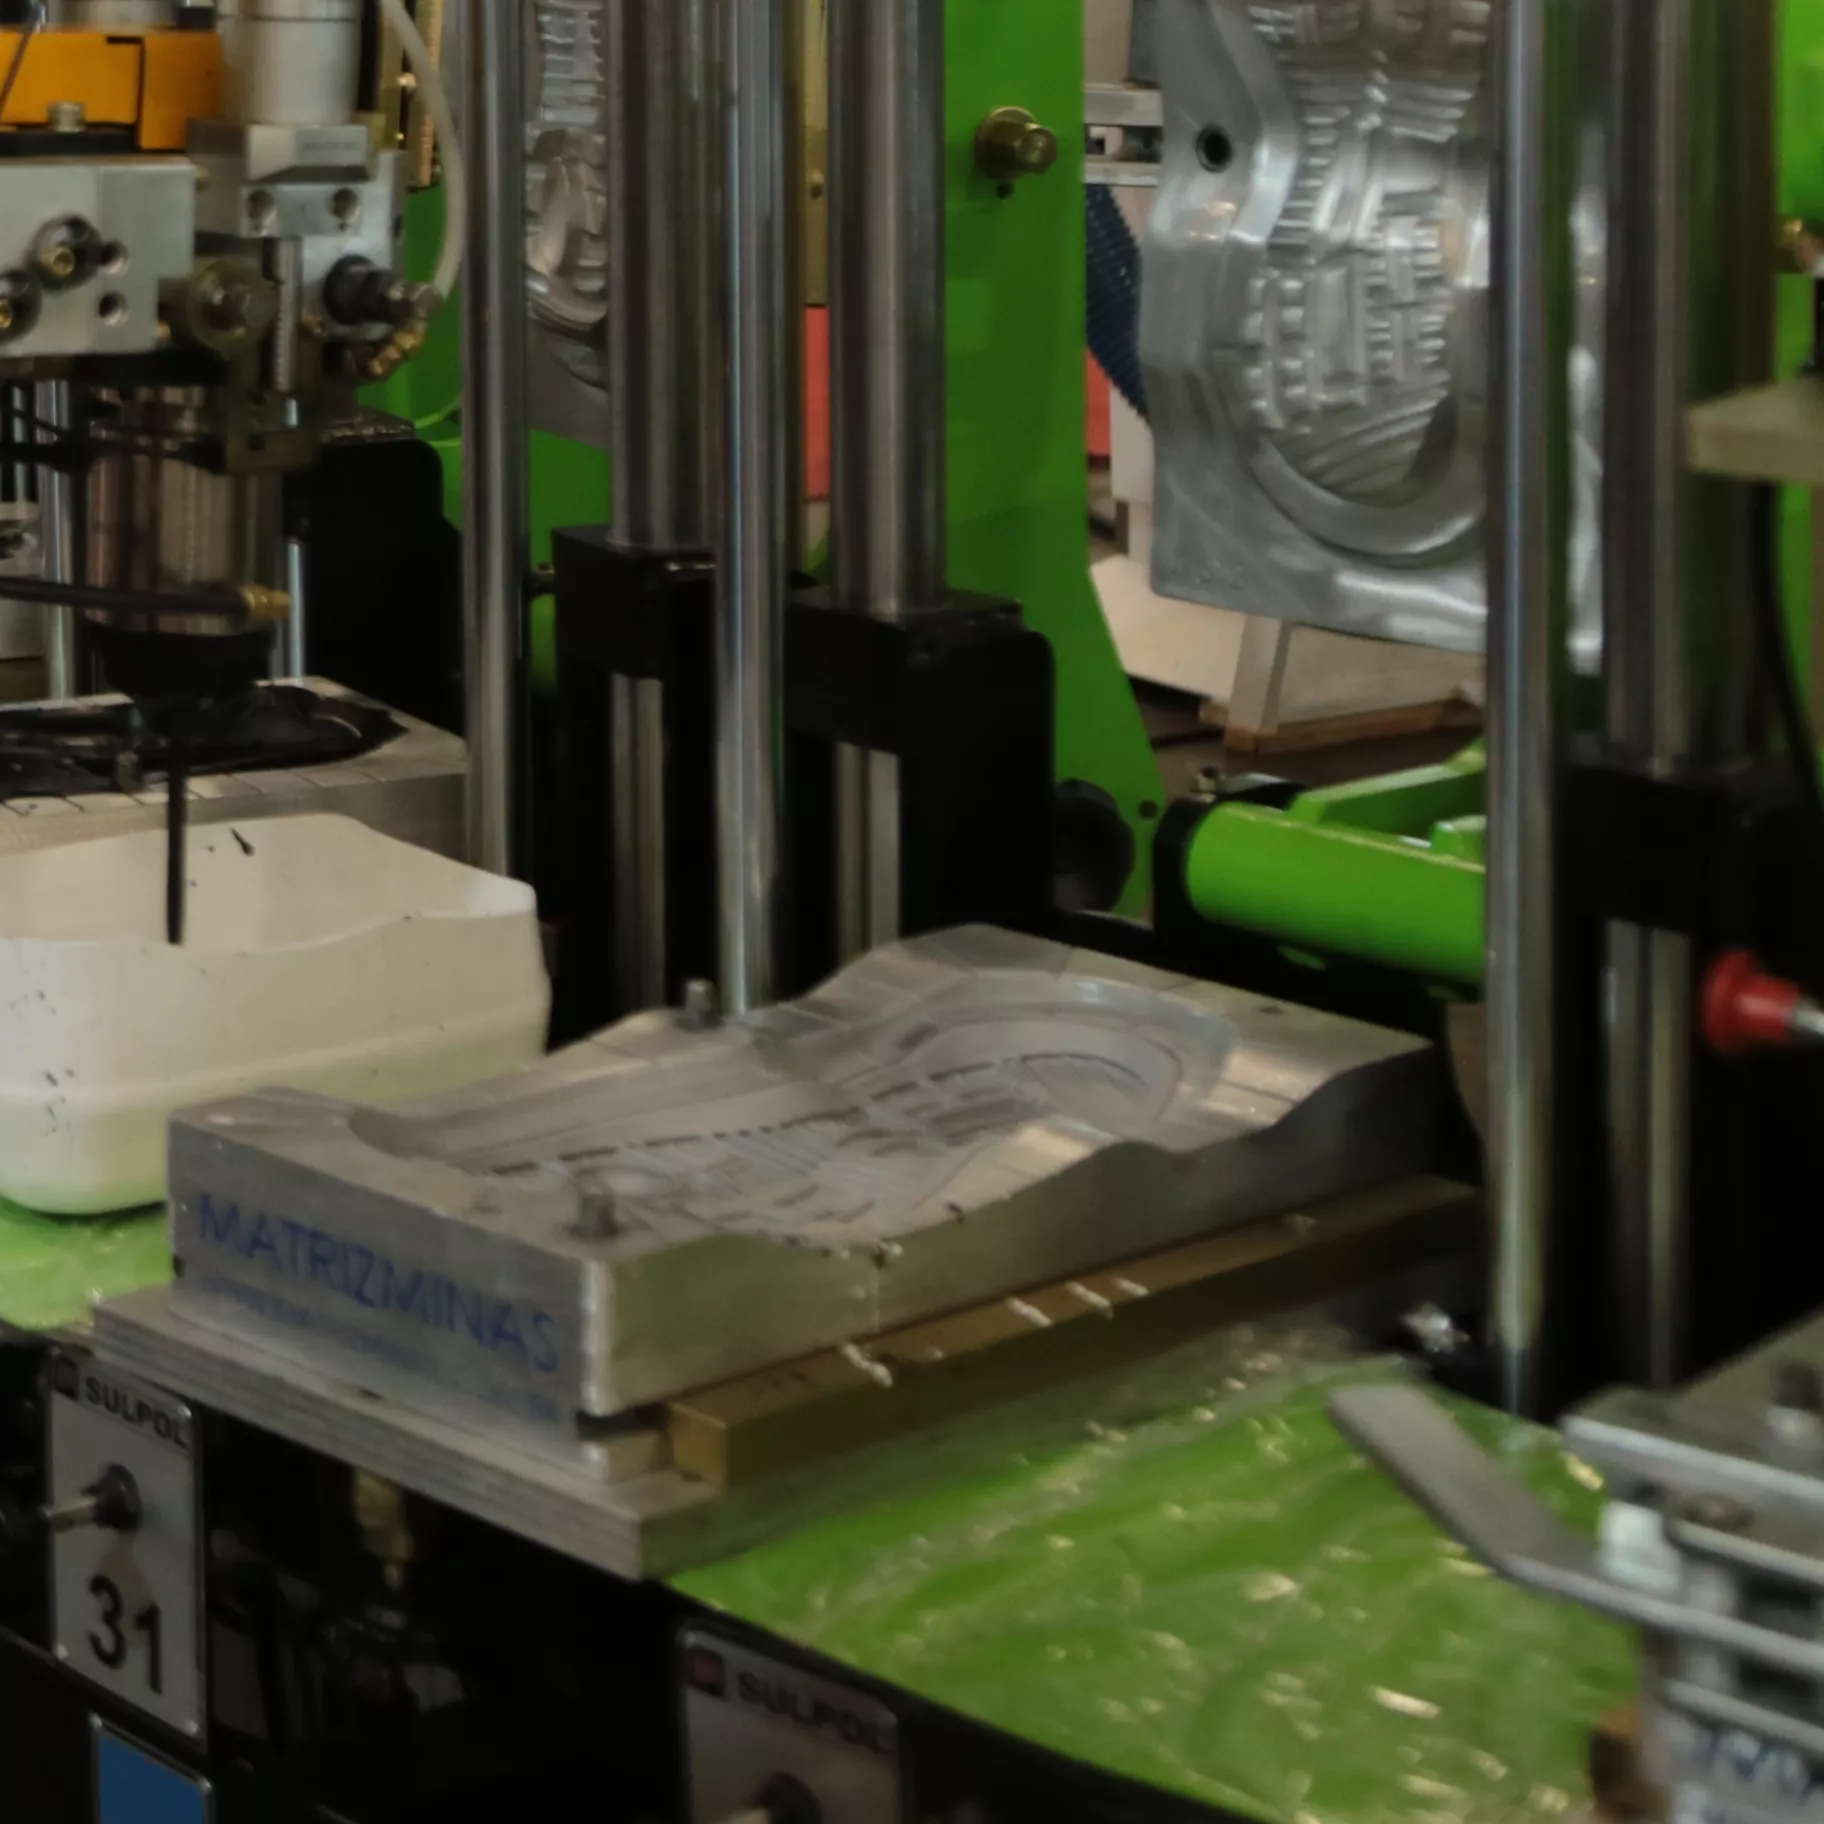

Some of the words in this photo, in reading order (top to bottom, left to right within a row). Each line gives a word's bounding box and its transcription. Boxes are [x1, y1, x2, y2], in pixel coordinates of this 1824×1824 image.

[199, 1193, 559, 1374] MATRIZMINAS
[85, 1376, 189, 1450] SULPOL
[87, 1573, 164, 1697] 31
[736, 1670, 897, 1756] SULPOL
